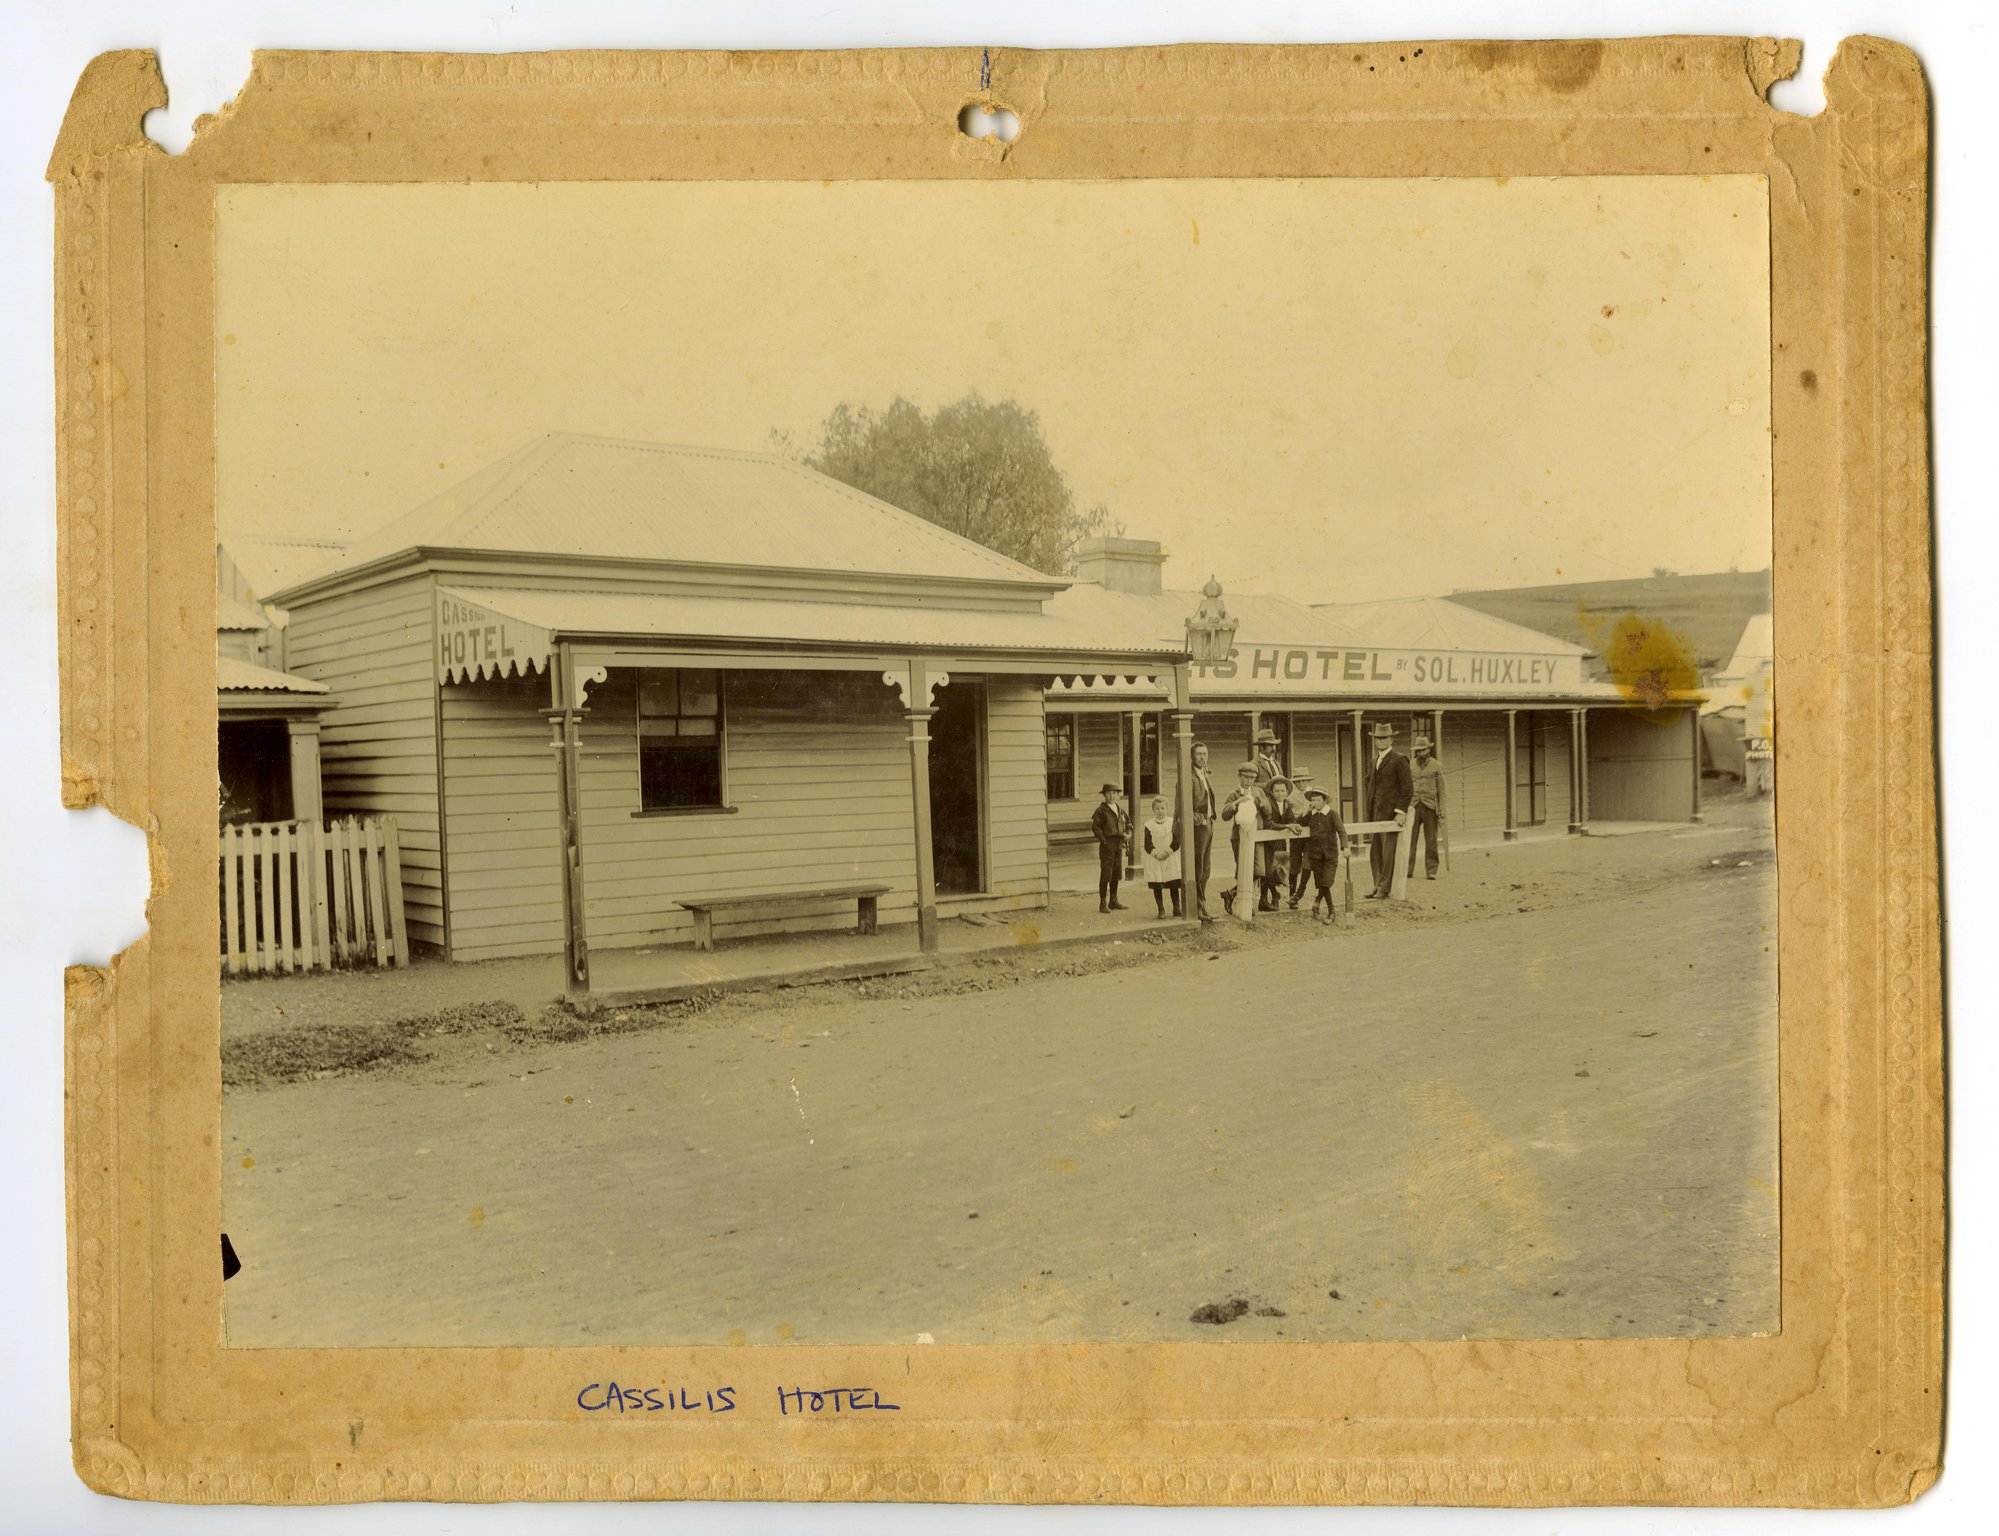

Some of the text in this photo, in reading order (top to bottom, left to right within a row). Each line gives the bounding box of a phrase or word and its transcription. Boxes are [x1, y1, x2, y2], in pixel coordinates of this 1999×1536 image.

[441, 624, 515, 665] HOTEL
[1252, 648, 1392, 681] HOTEL
[1396, 658, 1408, 670] BY
[1470, 657, 1557, 684] HUXLEY
[577, 1382, 901, 1415] CASSILIS HOTEL
